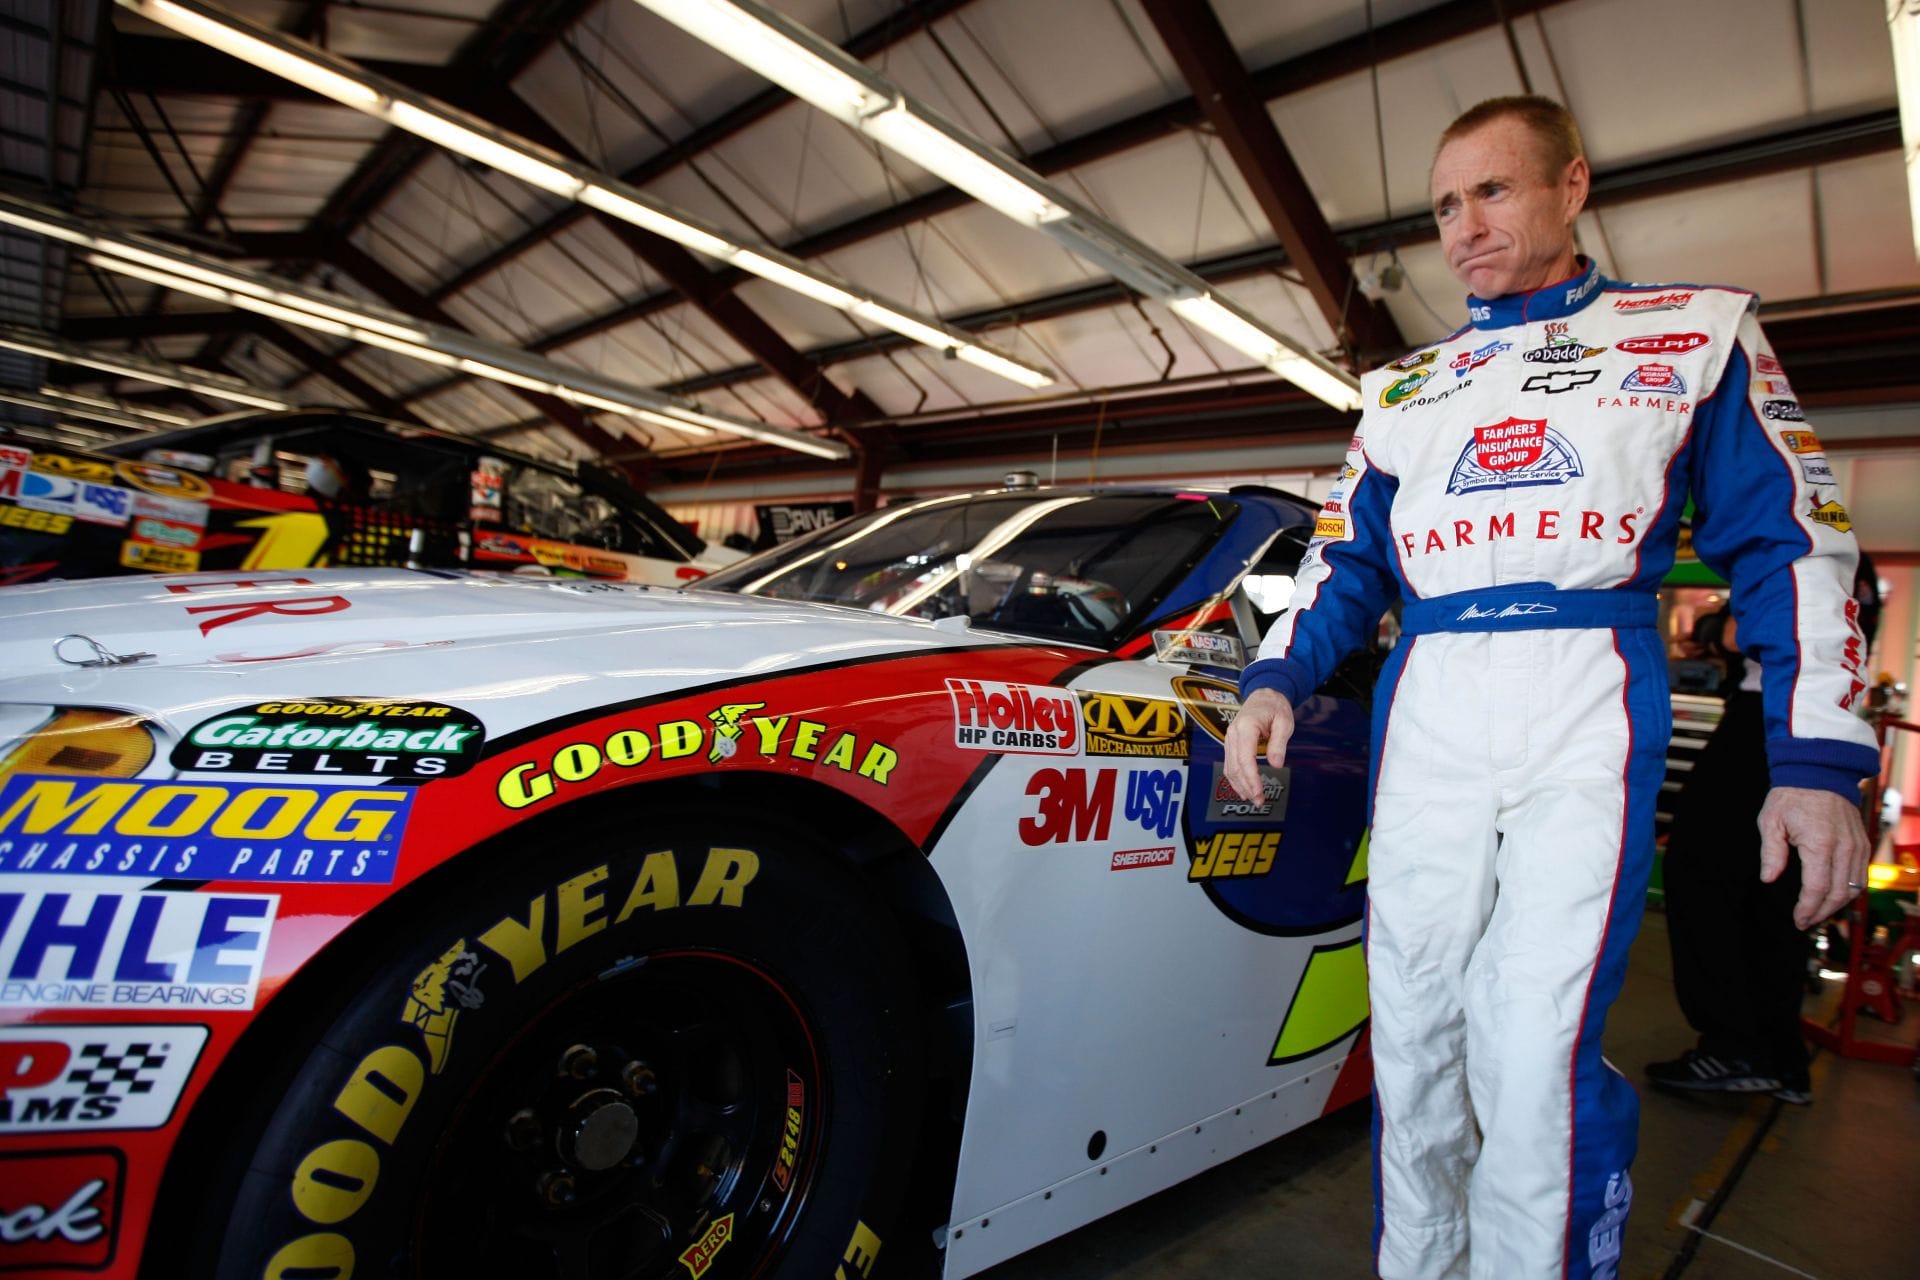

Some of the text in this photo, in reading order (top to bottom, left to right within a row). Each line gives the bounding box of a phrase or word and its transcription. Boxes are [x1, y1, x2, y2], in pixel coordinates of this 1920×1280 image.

[1623, 337, 1700, 349] DELPHI
[1483, 423, 1537, 440] FARMERS
[1477, 436, 1543, 454] INSURANCE
[1489, 451, 1529, 466] GROUP
[1462, 475, 1487, 487] Symbol
[1530, 470, 1561, 479] Service
[1317, 521, 1344, 533] BOSCH
[1402, 510, 1638, 558] FARMERS
[1190, 634, 1231, 654] NASCAR
[947, 679, 1076, 749] Holley
[194, 716, 468, 752] Gatorback
[958, 727, 1057, 748] HP CARBS
[1086, 731, 1189, 757] MECHANIX WEAR
[194, 751, 448, 775] BELTS
[0, 780, 407, 842] MOOG
[1018, 767, 1118, 847] 3M
[1124, 768, 1182, 839] USG
[1221, 804, 1273, 815] POLE
[229, 847, 370, 876] PARTS
[1112, 849, 1173, 868] SHEETROCK
[1189, 832, 1283, 878] JEGS
[0, 983, 247, 1006] ENGINE BEARINGS
[694, 1223, 727, 1268] AERO
